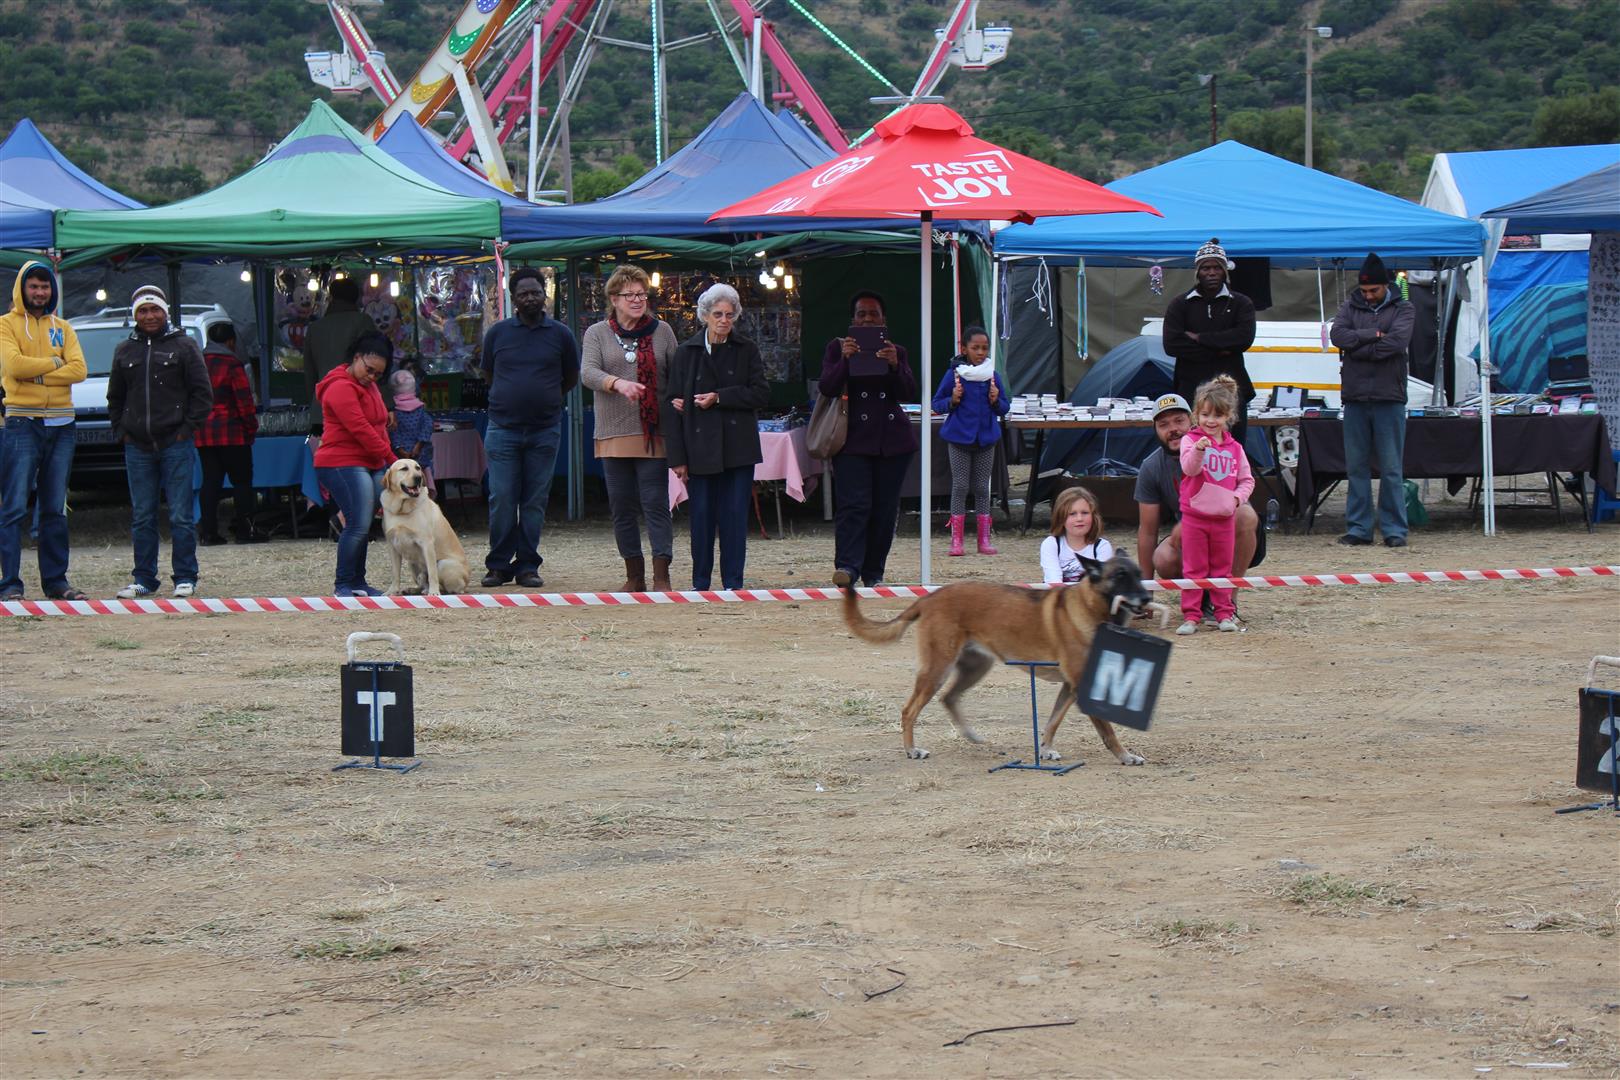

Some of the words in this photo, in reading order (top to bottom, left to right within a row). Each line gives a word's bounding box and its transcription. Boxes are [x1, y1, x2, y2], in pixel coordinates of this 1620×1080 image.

[911, 160, 1002, 176] TASTE
[932, 175, 1012, 200] JOY
[1203, 453, 1238, 476] OVE
[1089, 649, 1155, 712] M
[357, 691, 396, 741] T
